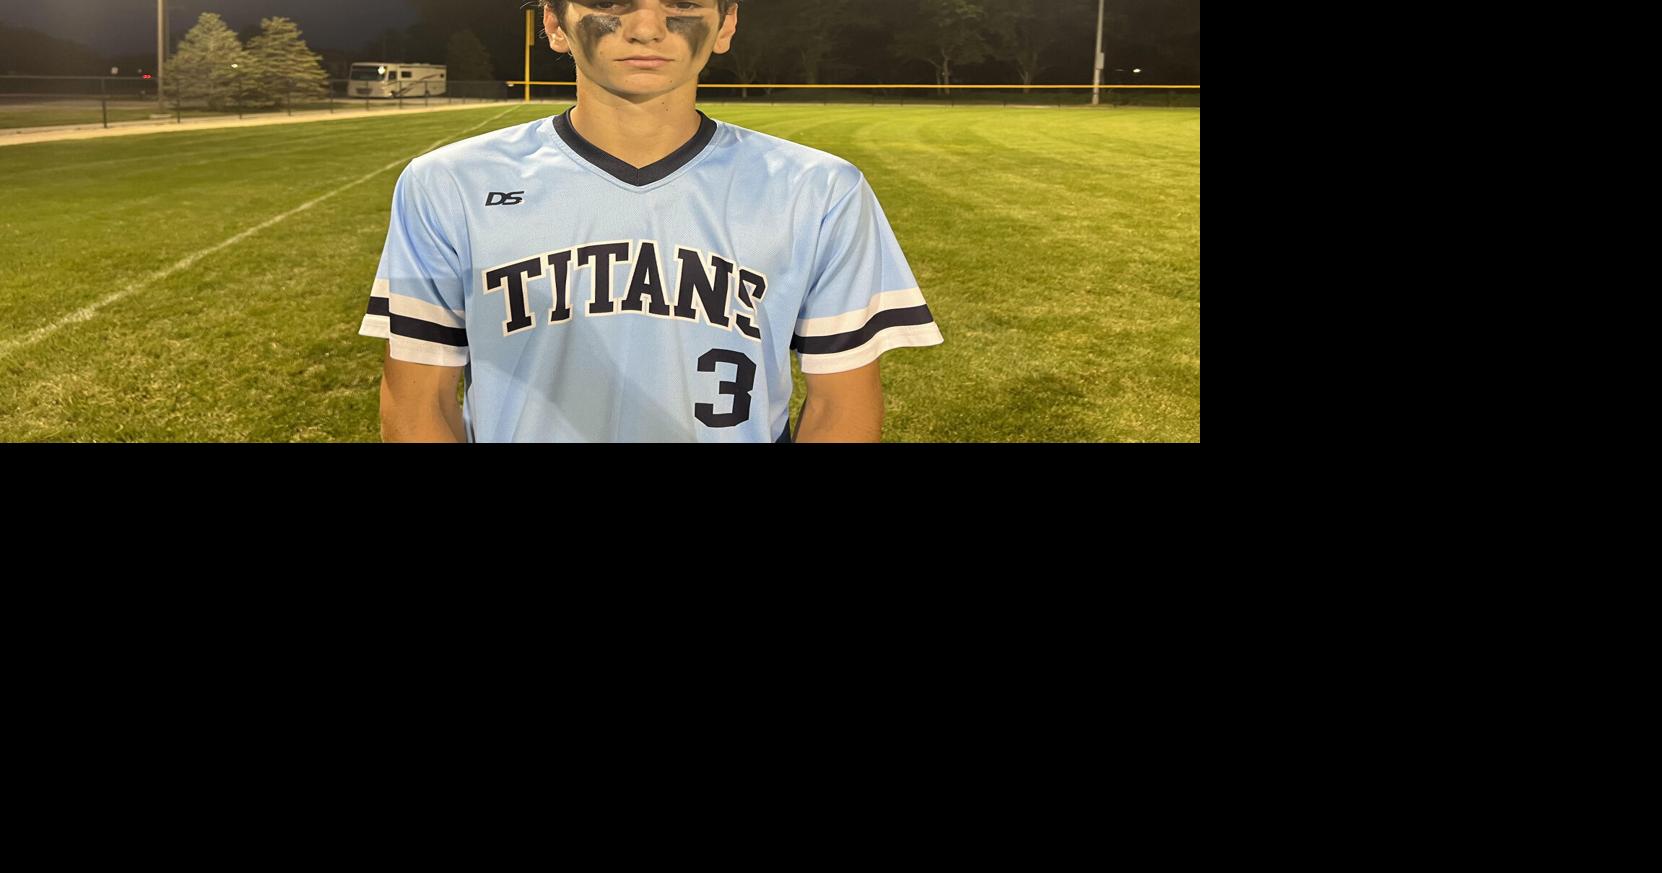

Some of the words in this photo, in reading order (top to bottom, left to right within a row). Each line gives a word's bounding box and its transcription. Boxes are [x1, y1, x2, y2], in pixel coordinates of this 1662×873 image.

[485, 190, 525, 206] DS
[483, 240, 768, 340] TITANS
[694, 348, 757, 428] 3
